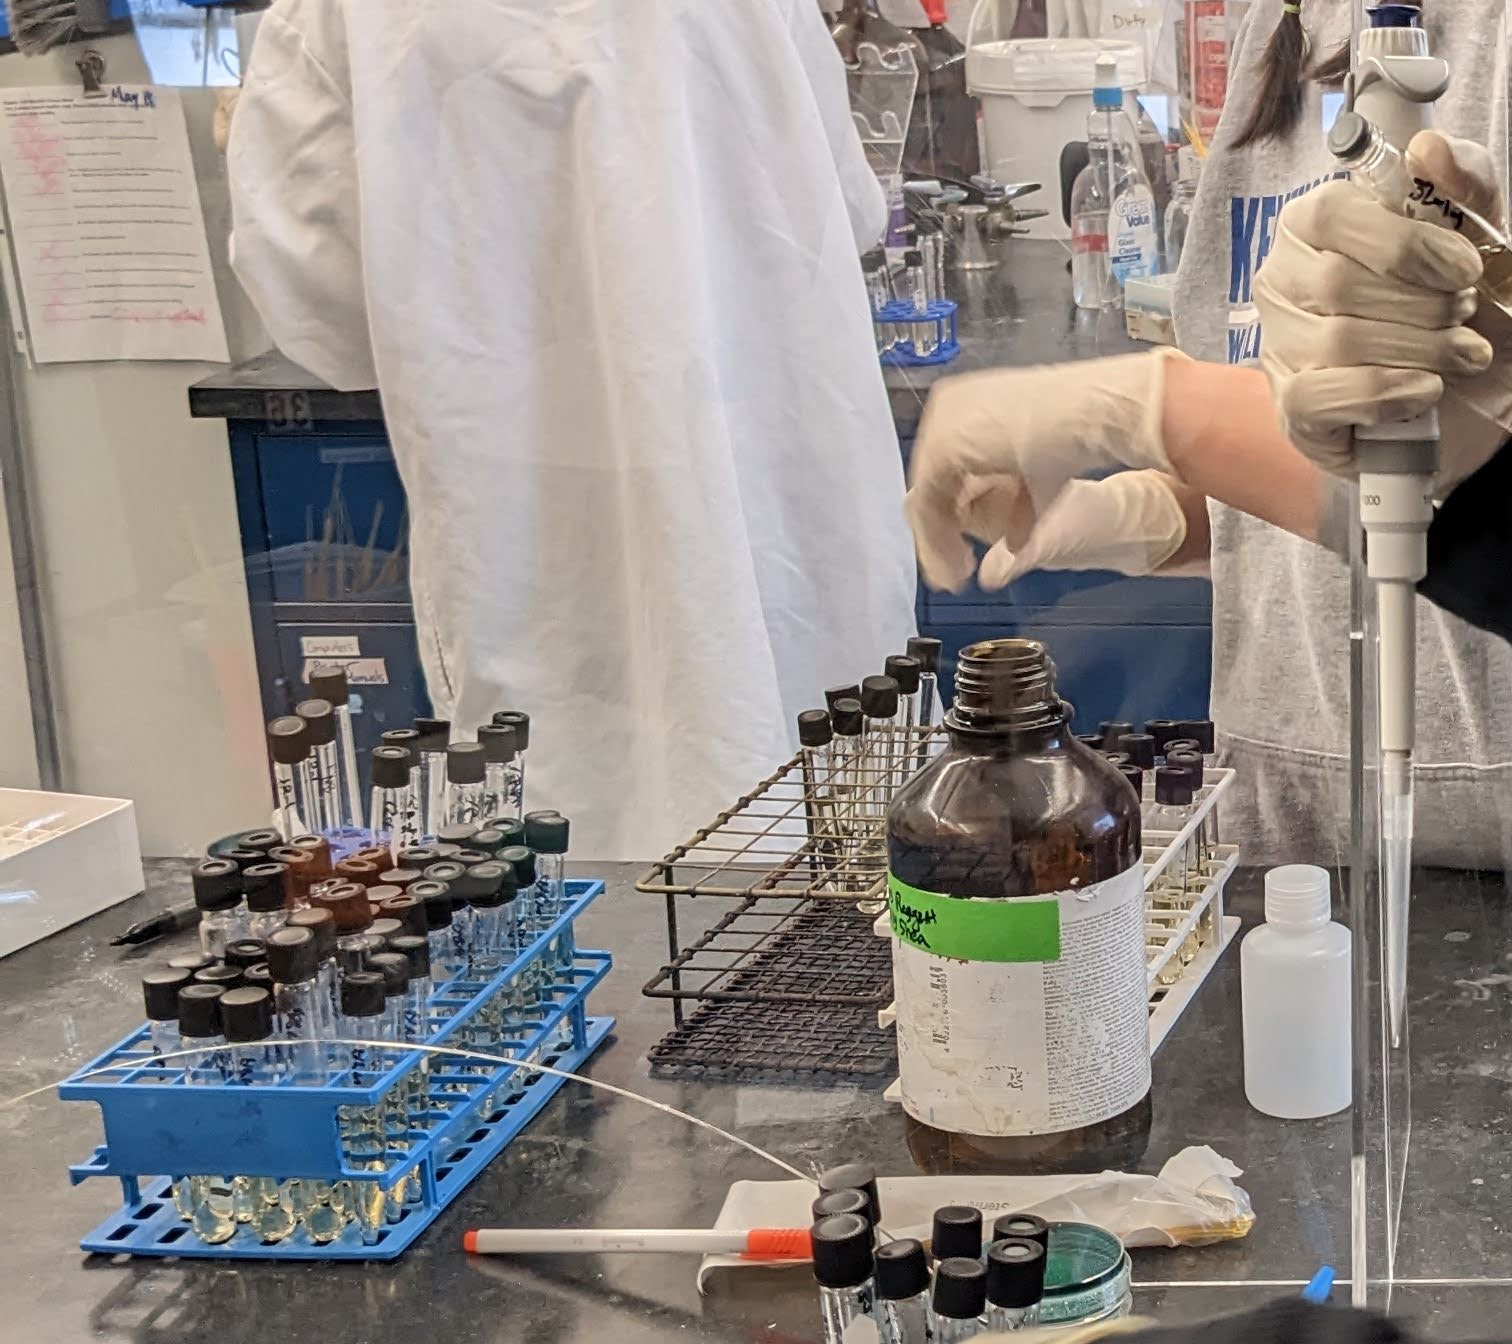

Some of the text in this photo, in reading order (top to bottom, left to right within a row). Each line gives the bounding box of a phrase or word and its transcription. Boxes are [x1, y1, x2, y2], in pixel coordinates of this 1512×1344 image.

[111, 85, 140, 111] May
[1115, 198, 1149, 217] Great
[1126, 215, 1150, 228] Value
